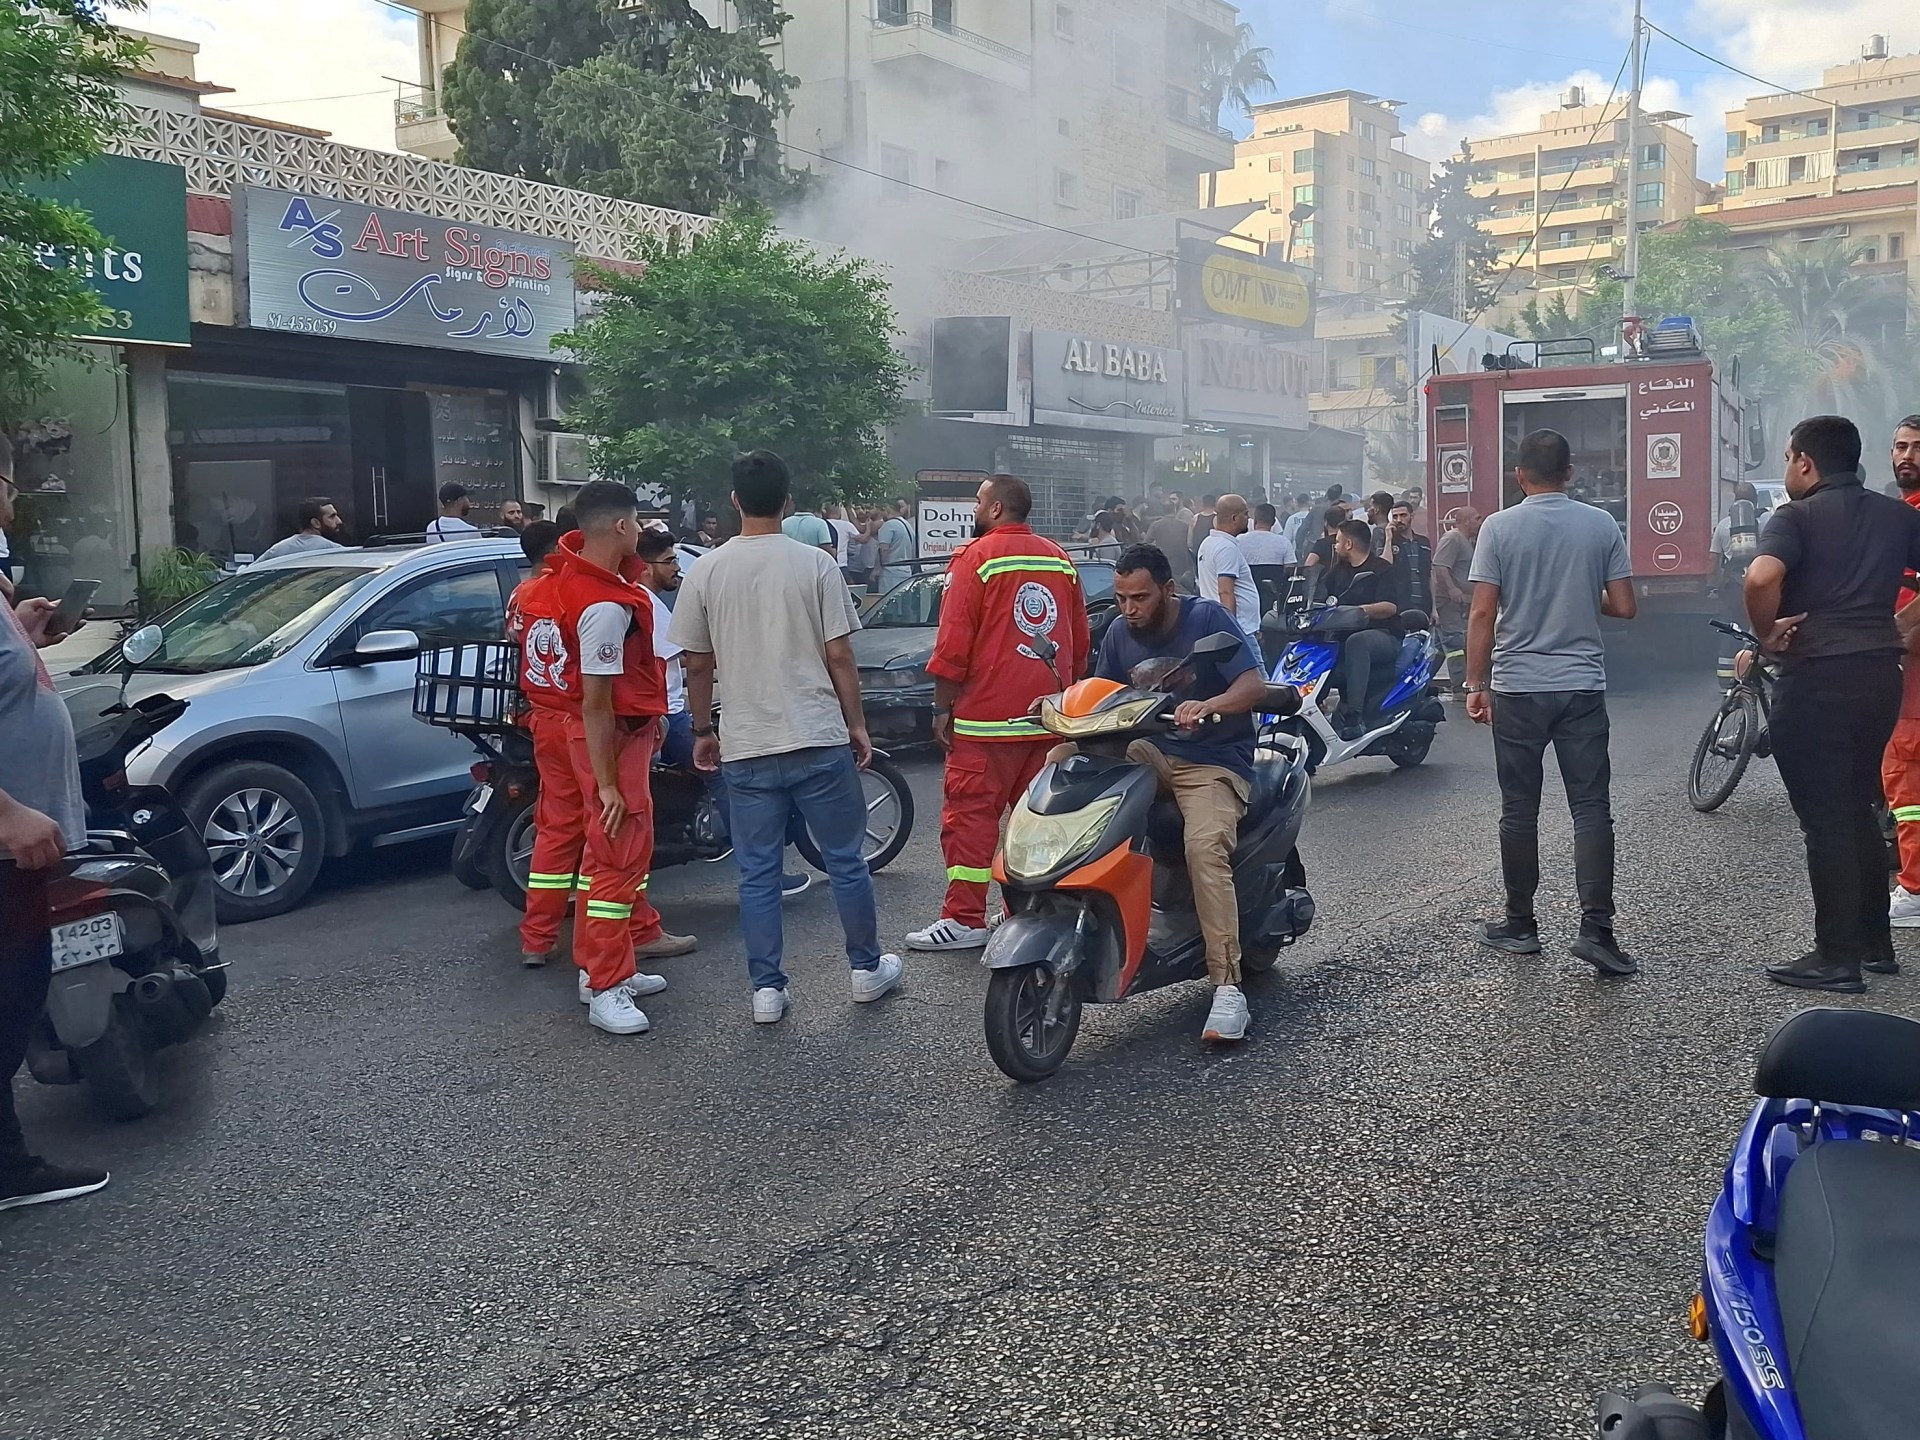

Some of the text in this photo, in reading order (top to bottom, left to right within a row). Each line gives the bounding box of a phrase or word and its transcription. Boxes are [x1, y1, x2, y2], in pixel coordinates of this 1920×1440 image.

[352, 212, 551, 288] Art Signs
[446, 266, 473, 283] Signs
[508, 277, 551, 296] Printing
[1211, 269, 1251, 304] OMT
[1063, 338, 1168, 383] AL BABA
[923, 507, 974, 522] Dohn
[1654, 508, 1678, 519] صيدا
[923, 541, 947, 554] Original
